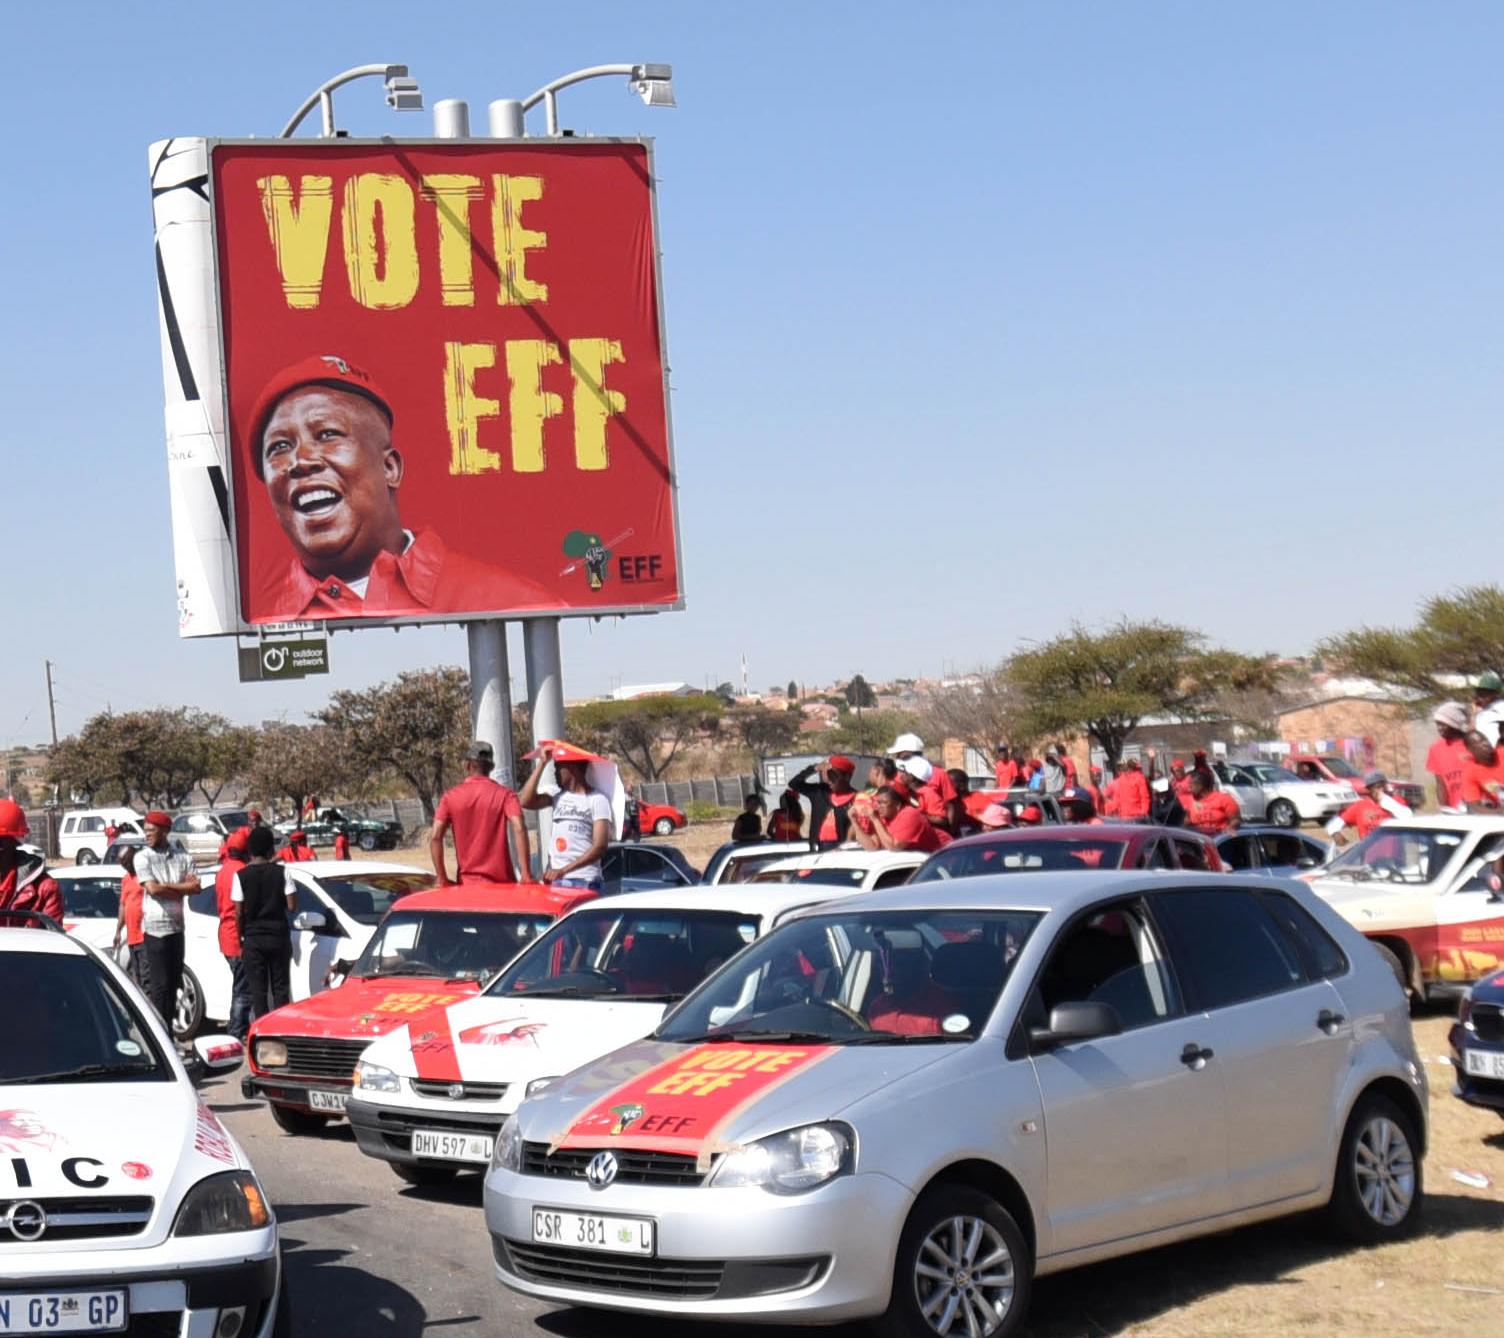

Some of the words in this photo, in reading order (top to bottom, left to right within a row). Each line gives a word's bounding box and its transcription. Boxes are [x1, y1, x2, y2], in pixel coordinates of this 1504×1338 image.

[256, 172, 548, 310] VOTE
[442, 337, 627, 475] EFF
[618, 554, 662, 580] EFF
[292, 648, 323, 658] outdoor
[292, 658, 324, 668] network
[678, 1050, 808, 1072] VOTE
[646, 1072, 746, 1096] EFF
[640, 1115, 696, 1133] EFF
[415, 1133, 439, 1154] DHV
[442, 1136, 466, 1156] 597
[484, 1140, 492, 1159] L
[535, 1212, 563, 1241] CSR
[577, 1217, 606, 1245] 381
[640, 1223, 650, 1249] L
[28, 1297, 60, 1328] 03
[88, 1294, 119, 1325] GP
